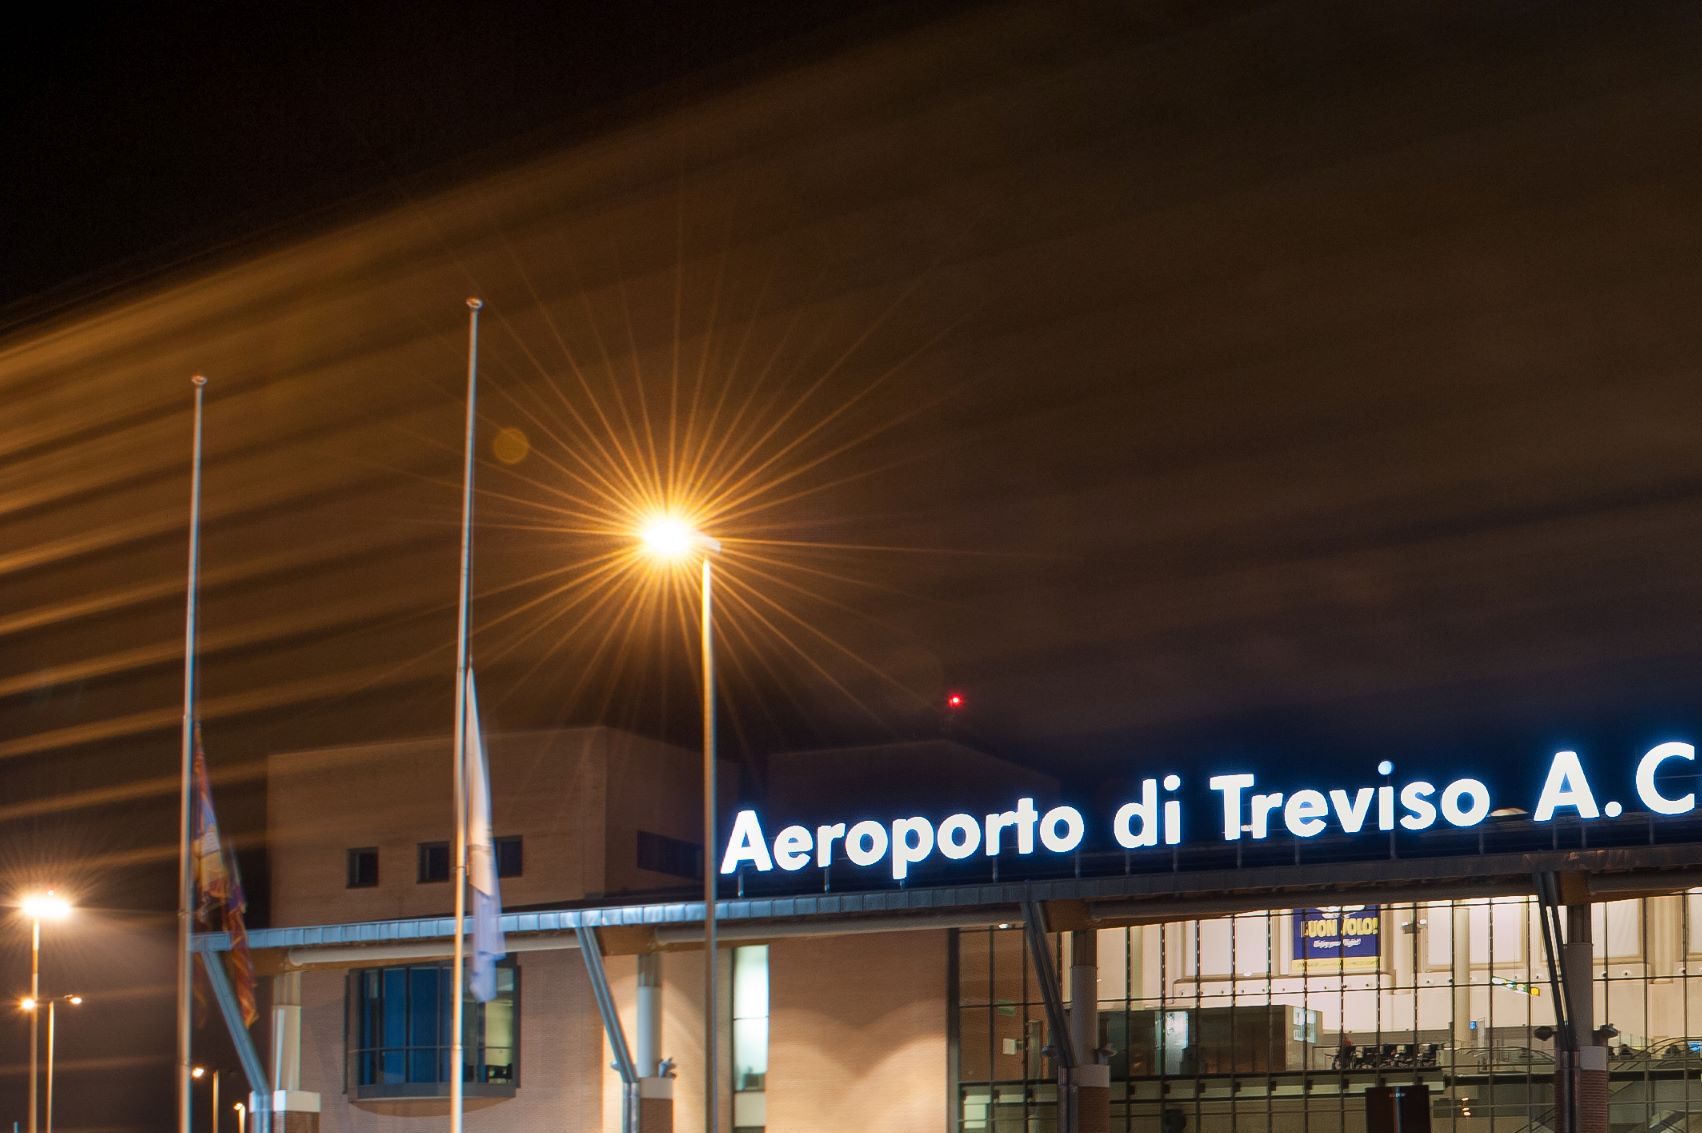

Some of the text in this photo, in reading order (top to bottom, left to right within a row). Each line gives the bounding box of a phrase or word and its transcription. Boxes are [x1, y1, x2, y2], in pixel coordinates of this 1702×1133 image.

[721, 798, 1085, 880] Aeroporto
[1113, 774, 1181, 849] di
[1209, 760, 1490, 840] Treviso
